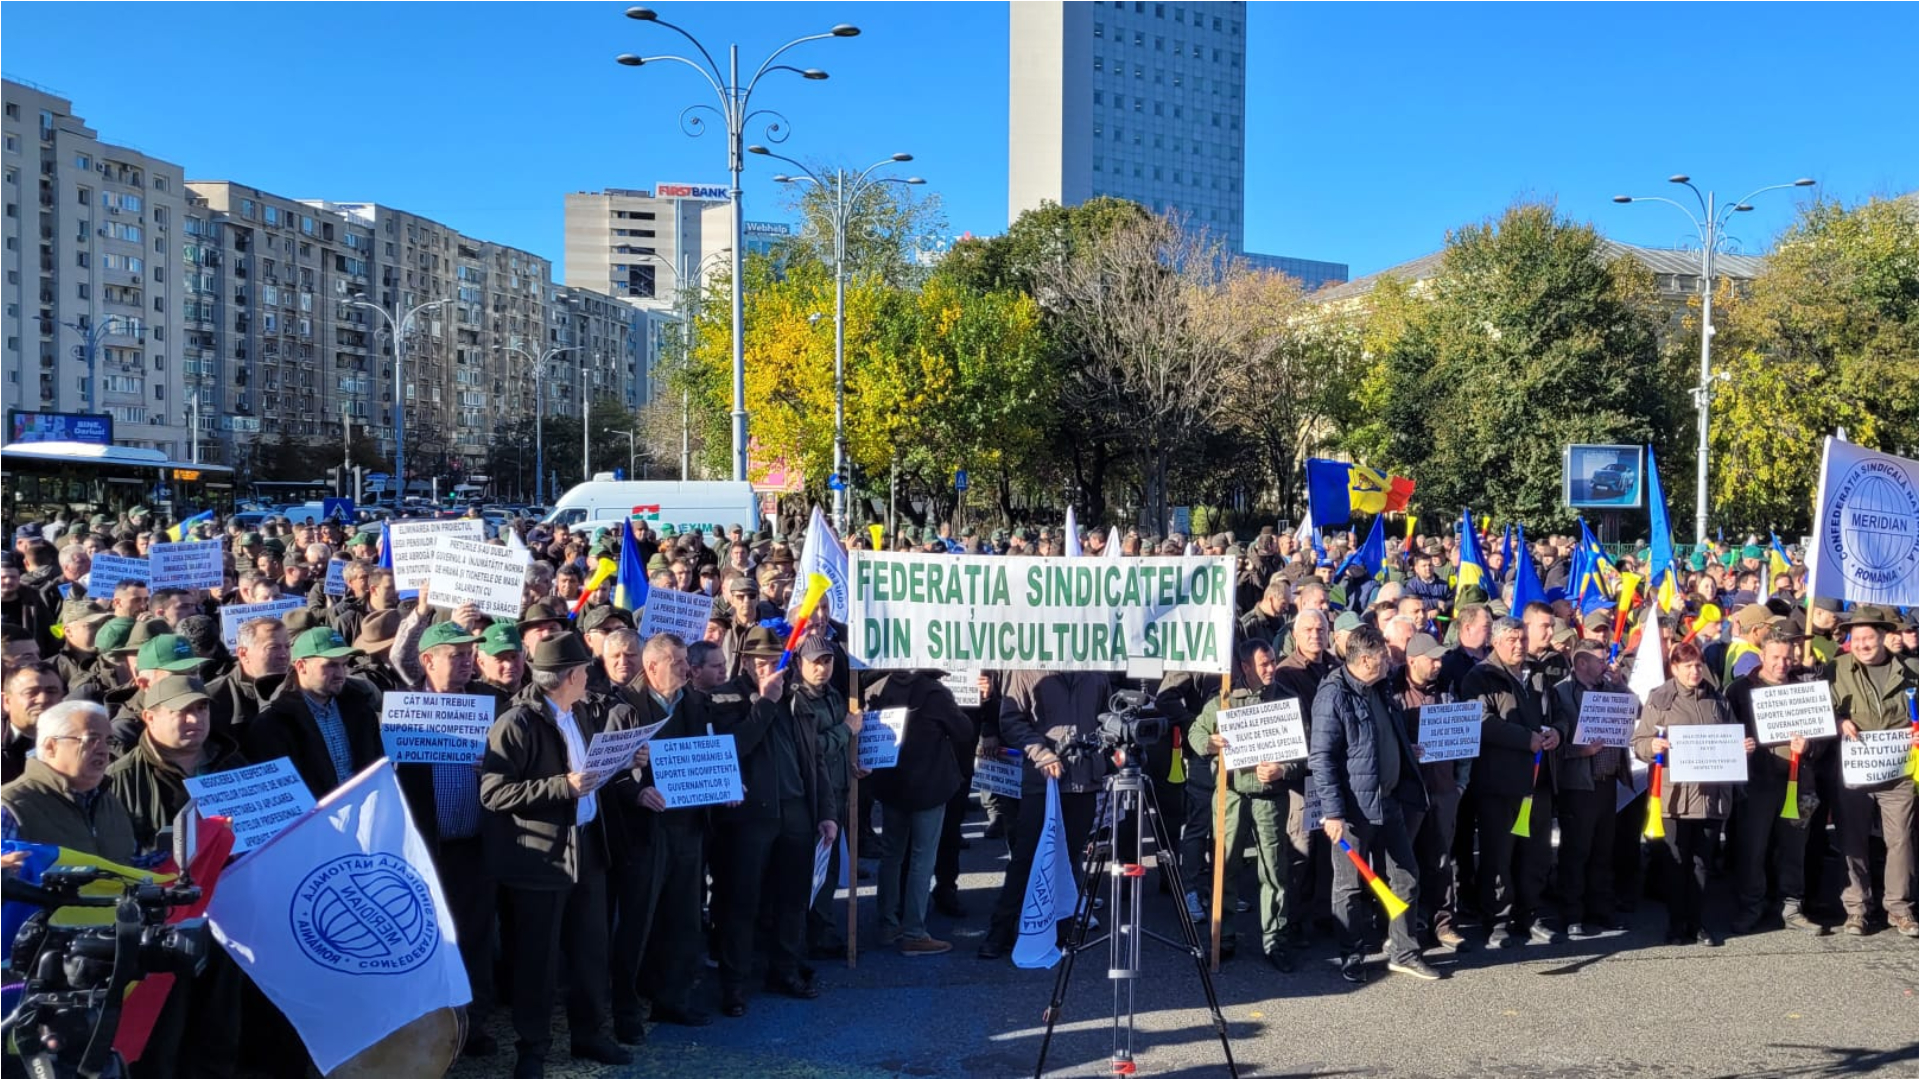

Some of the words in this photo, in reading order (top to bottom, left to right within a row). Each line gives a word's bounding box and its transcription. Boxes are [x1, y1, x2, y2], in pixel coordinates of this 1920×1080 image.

[658, 185, 727, 198] FIRSTBANK
[747, 222, 787, 234] Webhelp
[1851, 513, 1908, 533] MERIDIAN
[856, 559, 1011, 620] FEDERAȚIA
[1026, 564, 1227, 608] SINDICATELOR
[864, 618, 911, 660] DIN
[927, 611, 1127, 663] SILVICULTURĂ
[1143, 620, 1219, 663] SILVA
[403, 694, 420, 705] CÂT
[423, 697, 439, 706] MAI
[441, 697, 477, 708] TREBUIE
[388, 708, 433, 722] CETĂȚENII
[436, 708, 476, 721] ROMÂNIEI
[478, 710, 489, 722] SĂ
[383, 723, 425, 734] SUPORTE
[396, 736, 468, 751] GUVERNANȚILOR
[470, 739, 478, 750] ȘI
[664, 739, 678, 752] CÂT
[679, 740, 692, 751] MAI
[692, 738, 721, 750] TREBUIE
[396, 751, 403, 760] A
[405, 750, 477, 763] POLITICIENILOR?
[655, 752, 690, 767] CETĂȚENII
[692, 750, 723, 763] ROMÂNIEI
[725, 748, 733, 760] SĂ
[655, 768, 686, 780] SUPORTE
[667, 780, 723, 794] GUVERNANȚILOR
[671, 795, 677, 805] A
